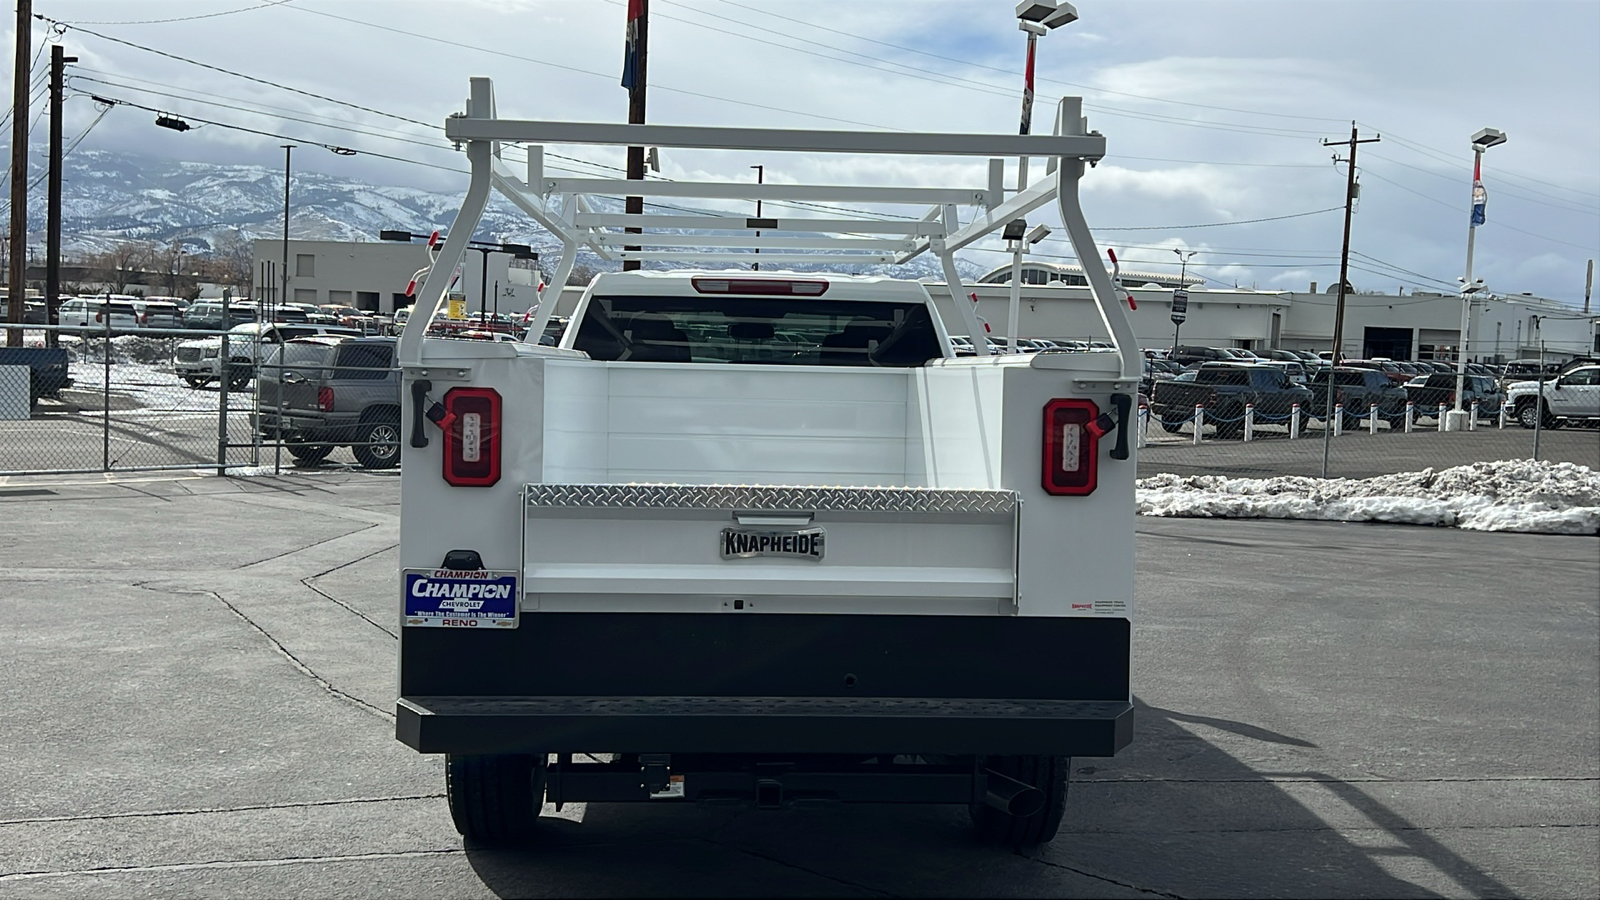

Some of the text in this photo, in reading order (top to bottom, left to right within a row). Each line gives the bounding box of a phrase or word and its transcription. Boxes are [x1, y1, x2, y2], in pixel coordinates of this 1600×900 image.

[725, 531, 820, 556] KNAPHEIDE
[434, 570, 489, 579] CHAMPION
[412, 578, 511, 599] CHAMPION
[442, 619, 478, 627] RENO
